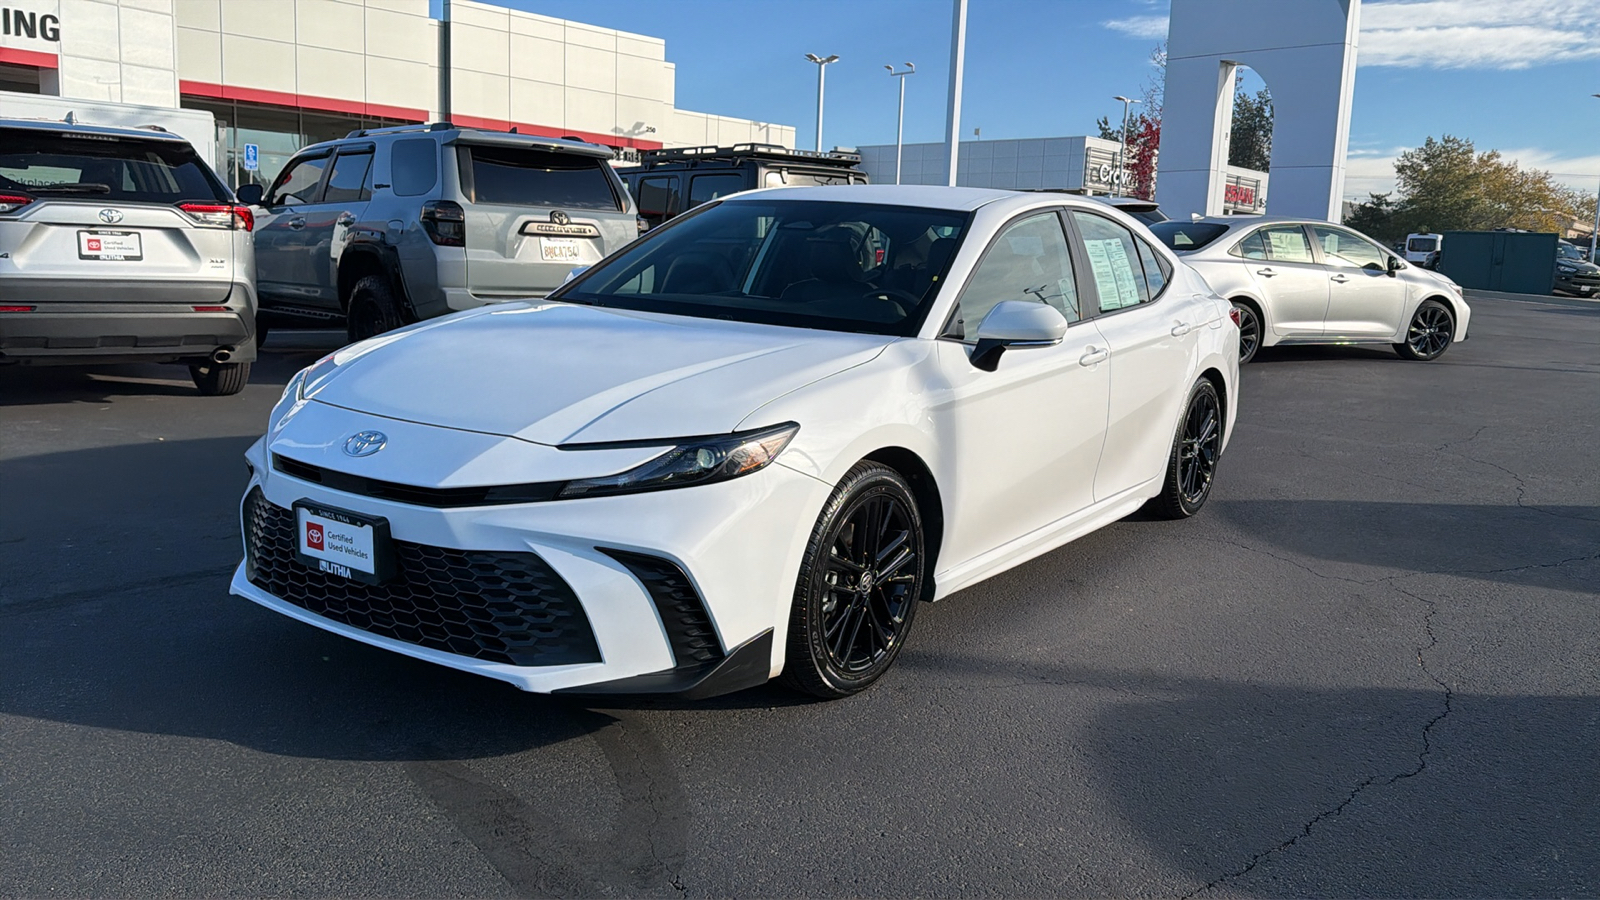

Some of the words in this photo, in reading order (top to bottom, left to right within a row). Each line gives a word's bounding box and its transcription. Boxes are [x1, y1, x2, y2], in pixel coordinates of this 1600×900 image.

[3, 8, 60, 42] ING
[318, 510, 336, 520] SINCE
[327, 531, 354, 544] Certified
[328, 542, 343, 552] Used
[344, 546, 368, 560] Vehicles
[326, 562, 352, 580] LITHIA
